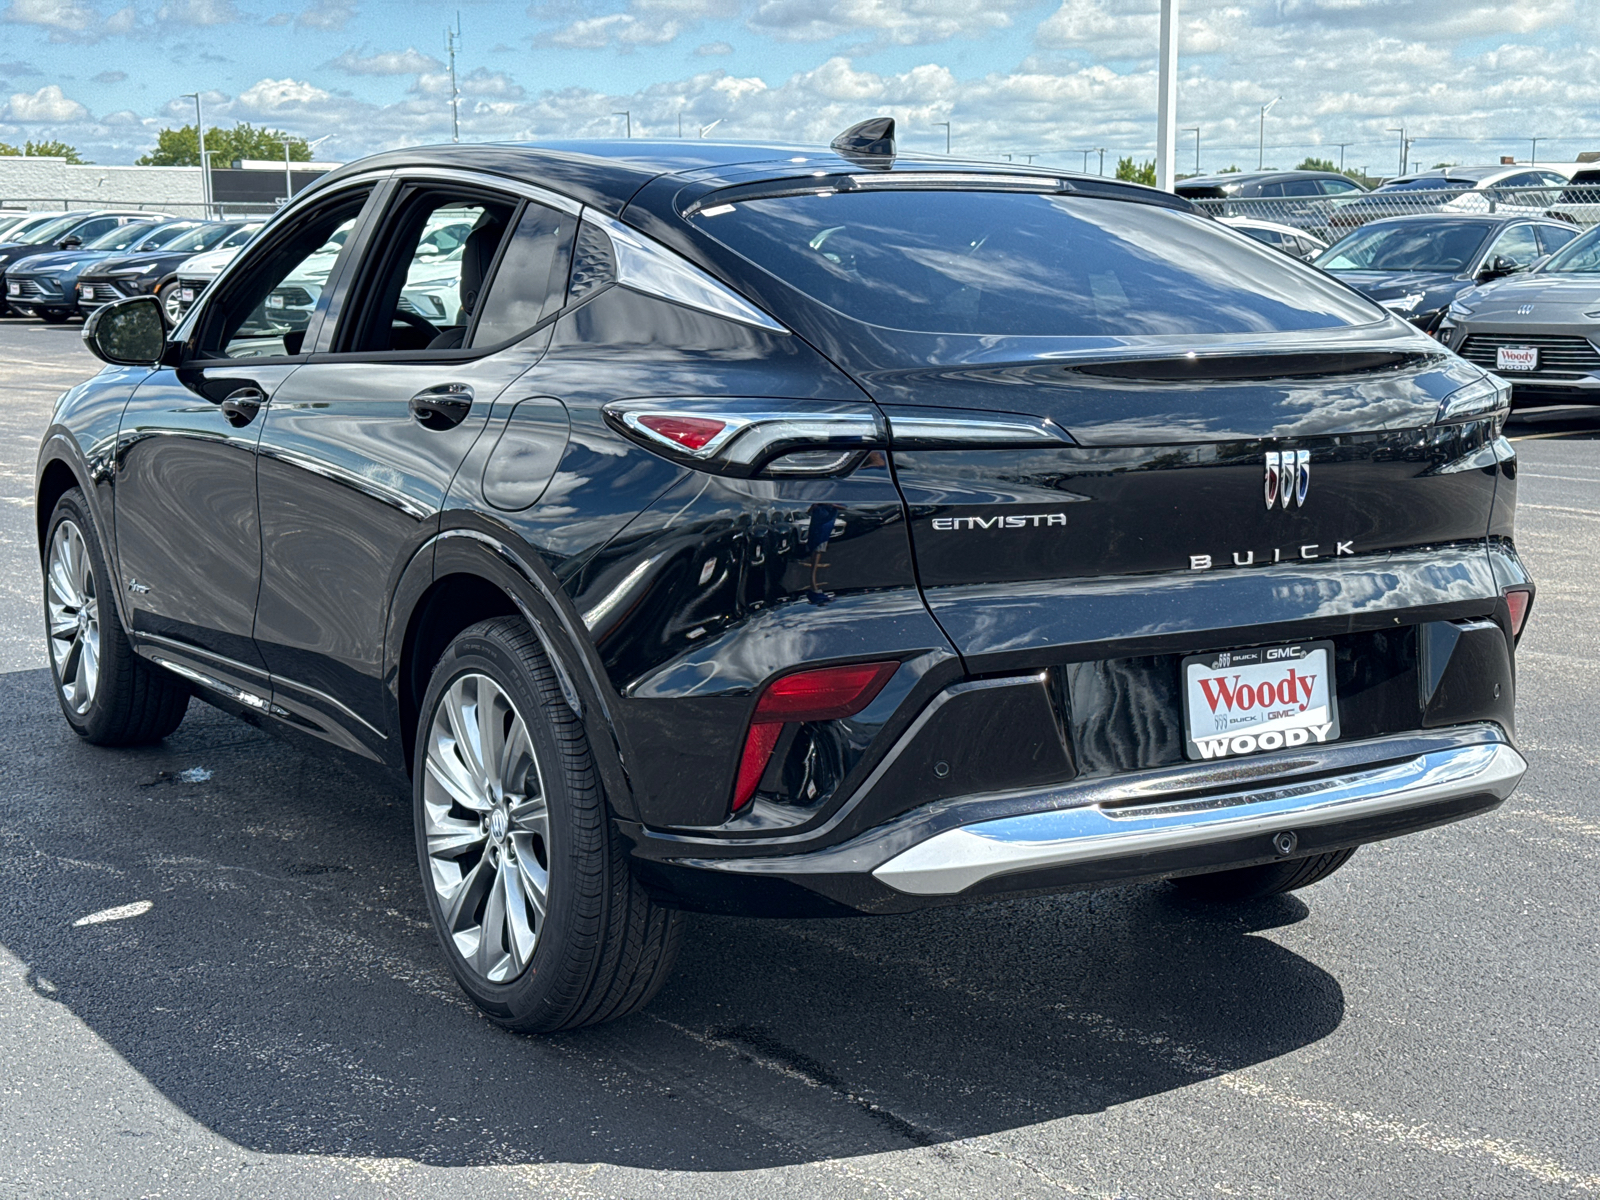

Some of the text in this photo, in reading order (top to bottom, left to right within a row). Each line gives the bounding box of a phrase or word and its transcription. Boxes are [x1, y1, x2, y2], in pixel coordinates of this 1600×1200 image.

[1501, 350, 1534, 363] Woody
[931, 512, 1067, 531] ENVISTA
[1188, 540, 1355, 570] BUICK
[1232, 646, 1302, 662] BUICK GMC
[1197, 668, 1317, 715] Woody
[1229, 708, 1296, 724] BUICK GMC
[1196, 721, 1334, 760] WOODY
